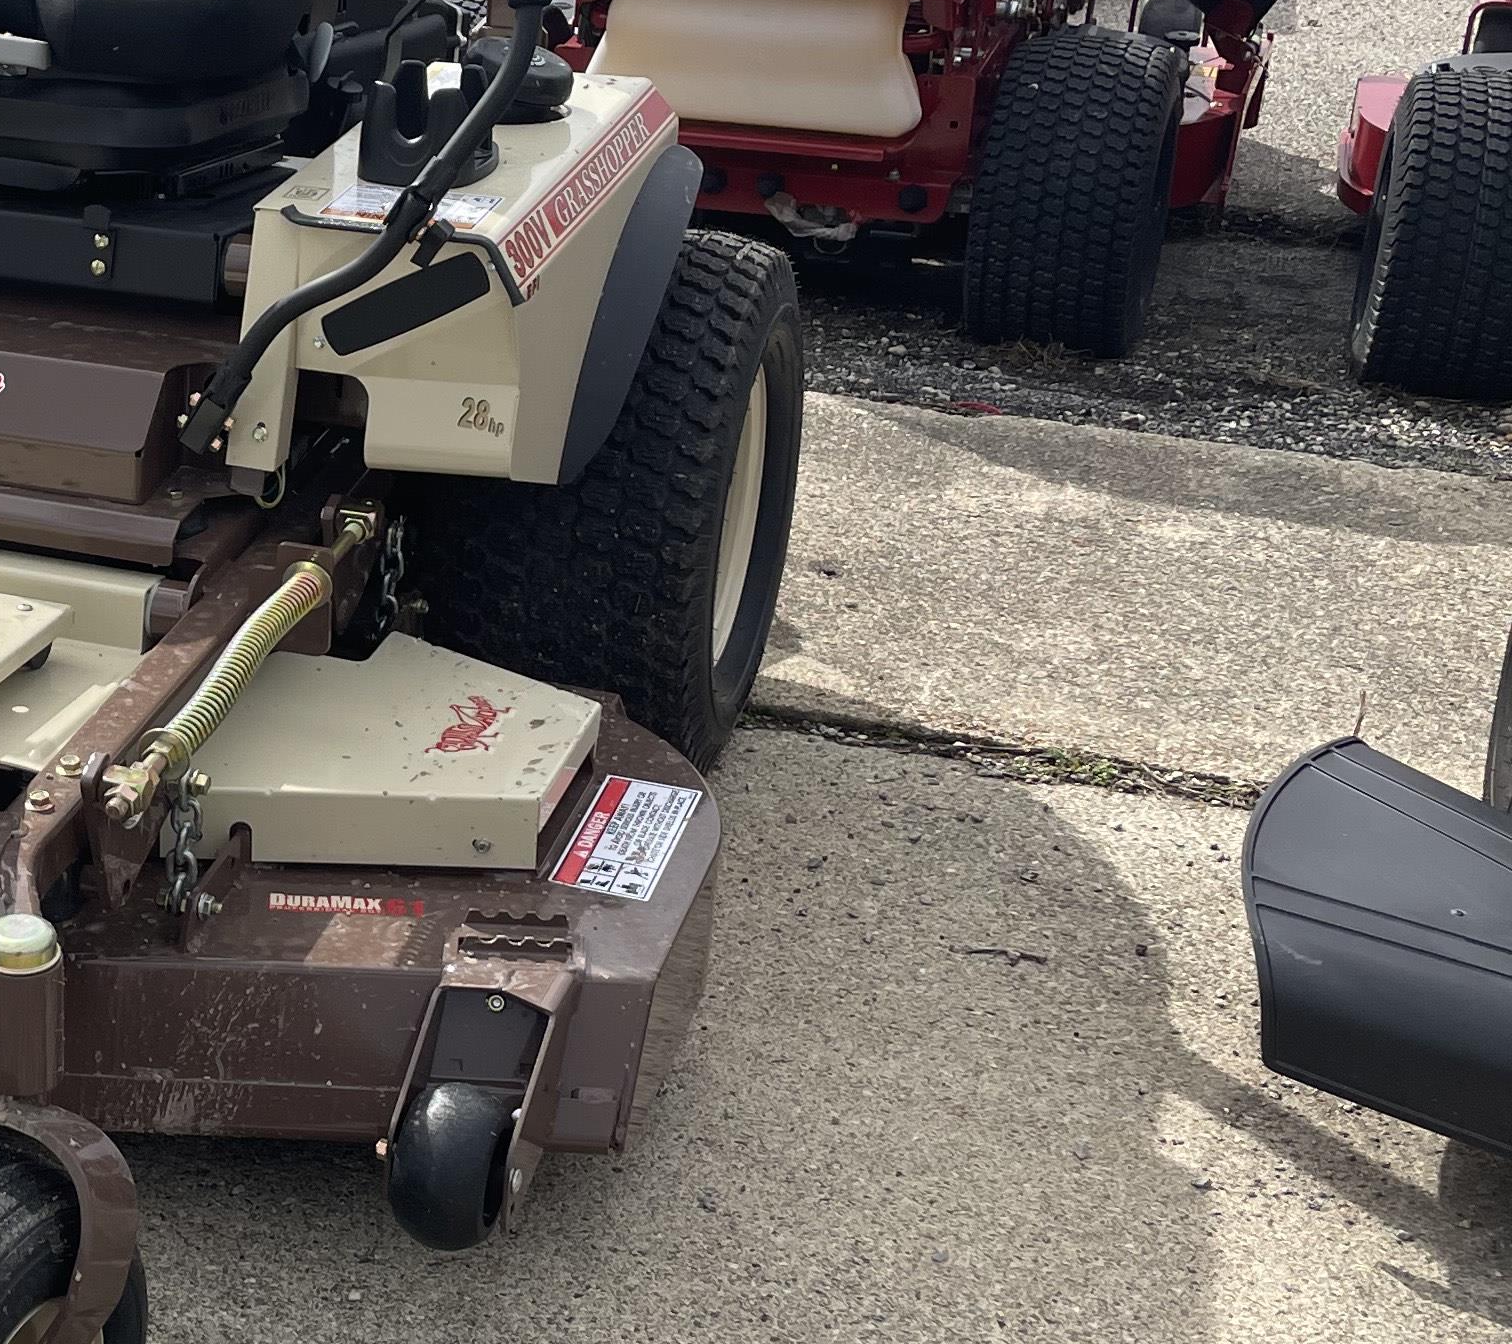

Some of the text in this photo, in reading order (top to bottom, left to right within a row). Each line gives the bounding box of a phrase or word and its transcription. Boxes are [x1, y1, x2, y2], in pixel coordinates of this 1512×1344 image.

[505, 112, 651, 278] 300V GRASSHOPPER
[576, 810, 609, 847] DANGER
